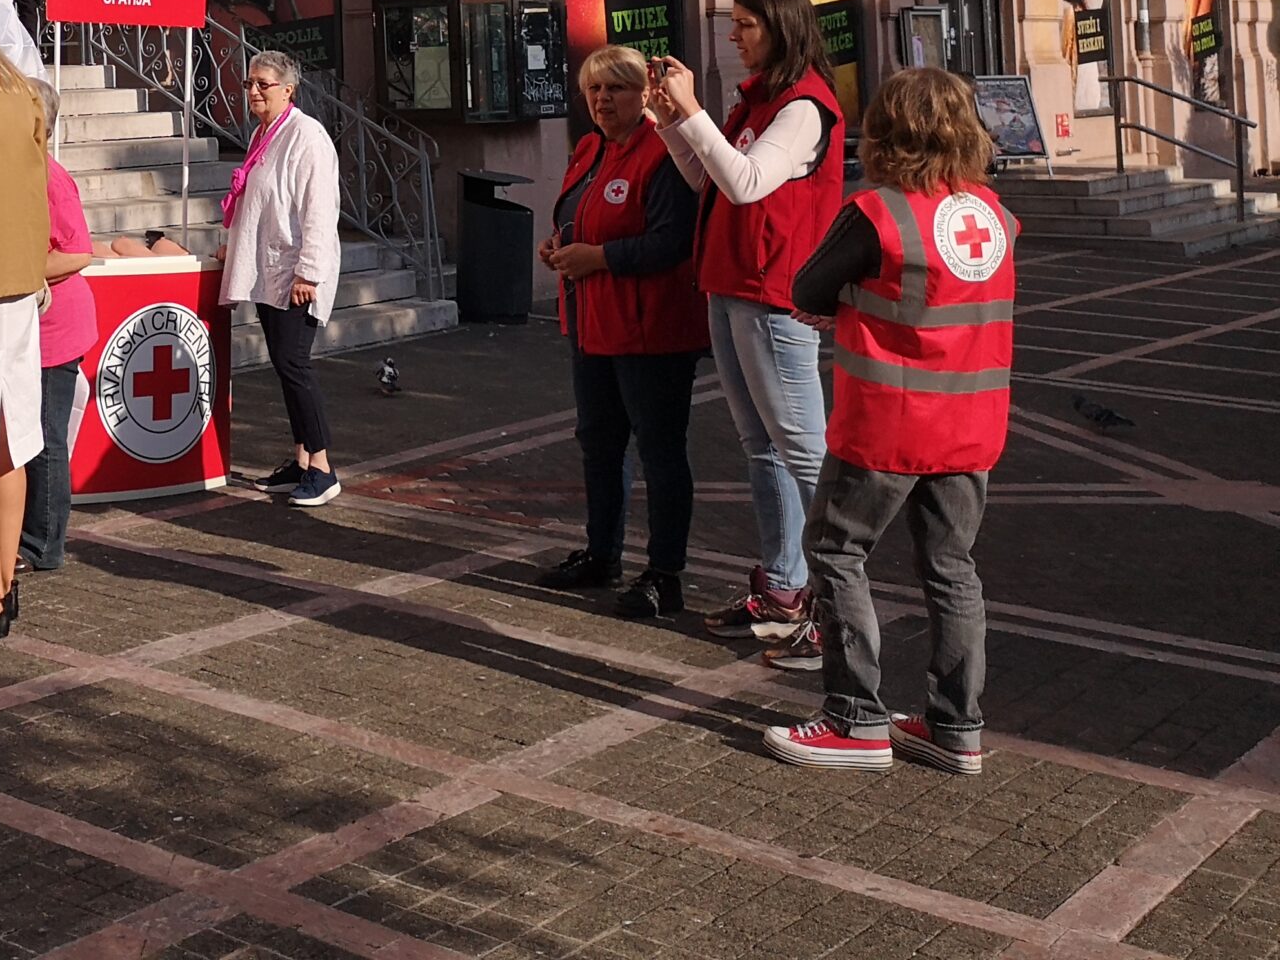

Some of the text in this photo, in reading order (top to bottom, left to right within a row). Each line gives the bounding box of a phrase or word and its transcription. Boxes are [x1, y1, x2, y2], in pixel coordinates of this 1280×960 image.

[611, 5, 669, 33] UVIJEK
[103, 318, 148, 428] HRVATSKI
[152, 310, 209, 360] CRVENI
